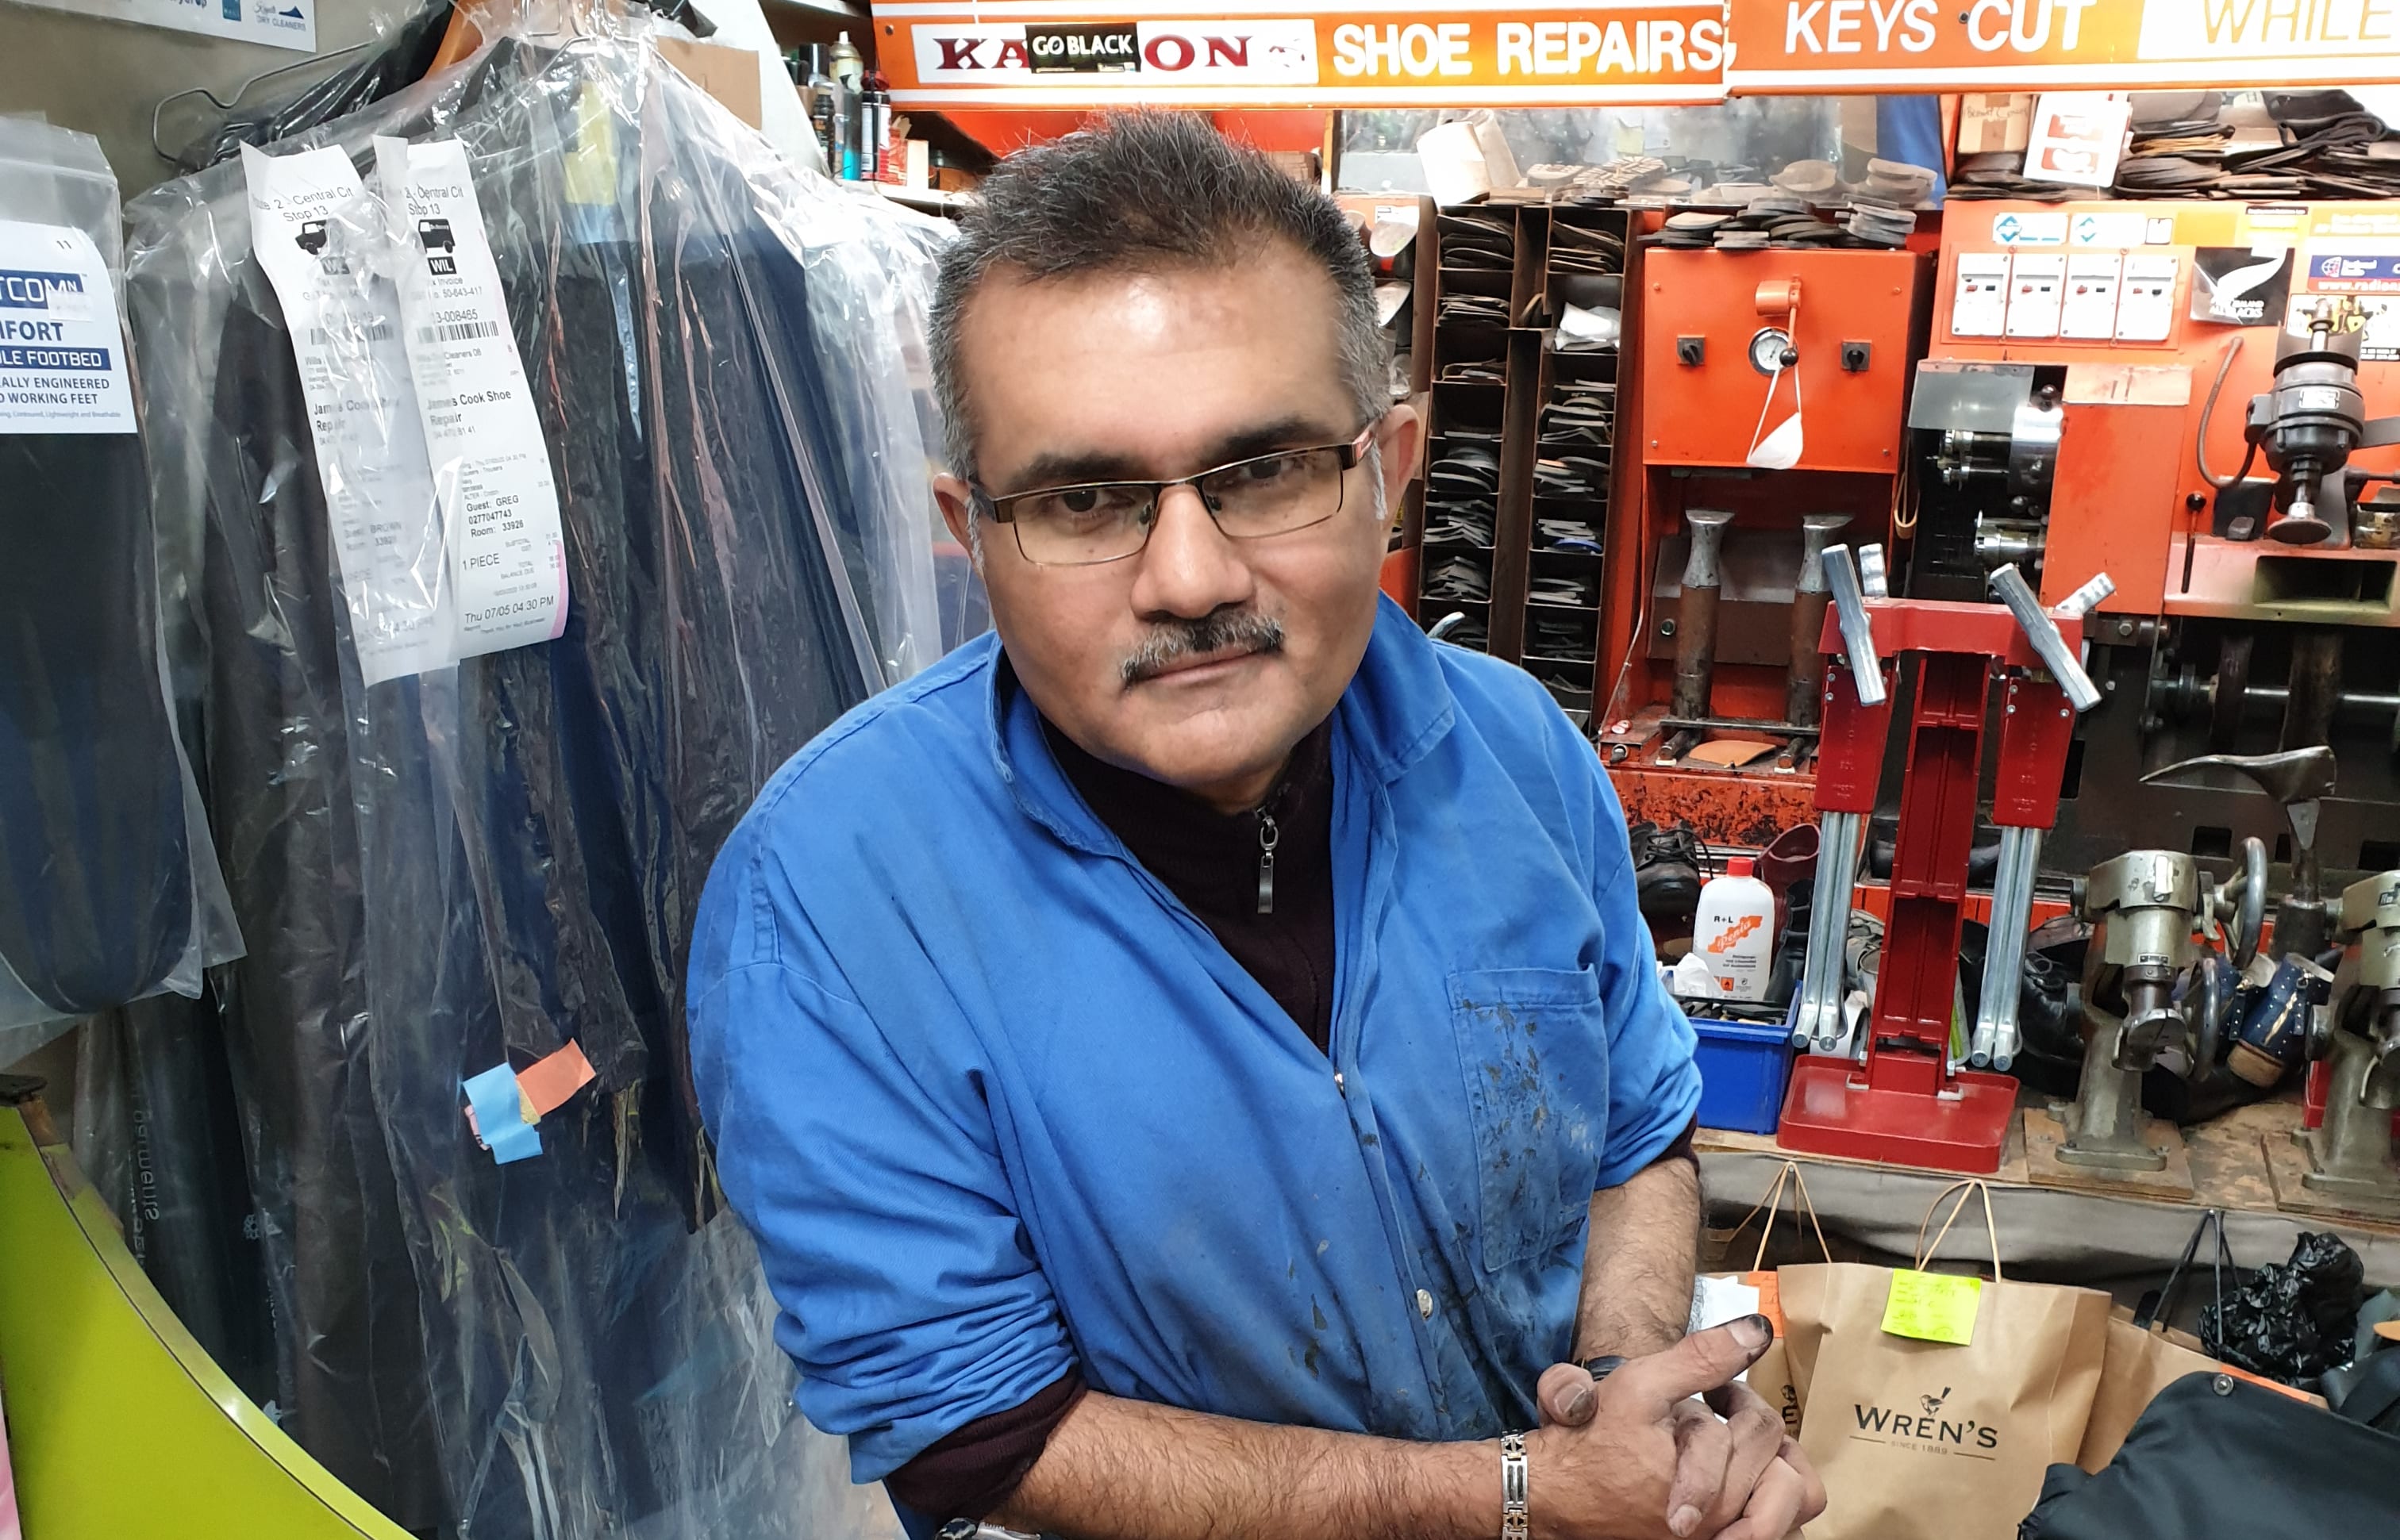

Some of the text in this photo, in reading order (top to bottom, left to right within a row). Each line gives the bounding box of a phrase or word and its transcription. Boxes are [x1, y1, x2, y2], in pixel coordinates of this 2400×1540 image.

[1785, 0, 2393, 54] KEYS CUT WHILE
[1033, 33, 1133, 56] GO BLACK
[1333, 20, 1724, 76] SHOE REPAIRS
[293, 189, 337, 205] Central
[283, 205, 329, 222] Stop 13
[408, 203, 440, 217] Stop 13
[431, 259, 453, 273] WIL
[0, 351, 102, 367] LE FOOTBED
[0, 376, 110, 389] ALLY ENGINEERED
[7, 393, 67, 404] WORKING
[71, 394, 98, 404] FEET
[460, 392, 485, 405] Cook
[487, 390, 512, 401] Shoe
[430, 413, 463, 427] Repair
[467, 495, 519, 512] Guest: GREG
[468, 509, 513, 524] 0277047743
[471, 527, 497, 538] Room:
[470, 553, 500, 569] PIECE
[465, 613, 483, 624] Thu
[484, 605, 510, 620] 07/05
[540, 596, 554, 608] PM
[1854, 1404, 1998, 1449] WREN'S
[1891, 1440, 1948, 1455] SINCE 1889
